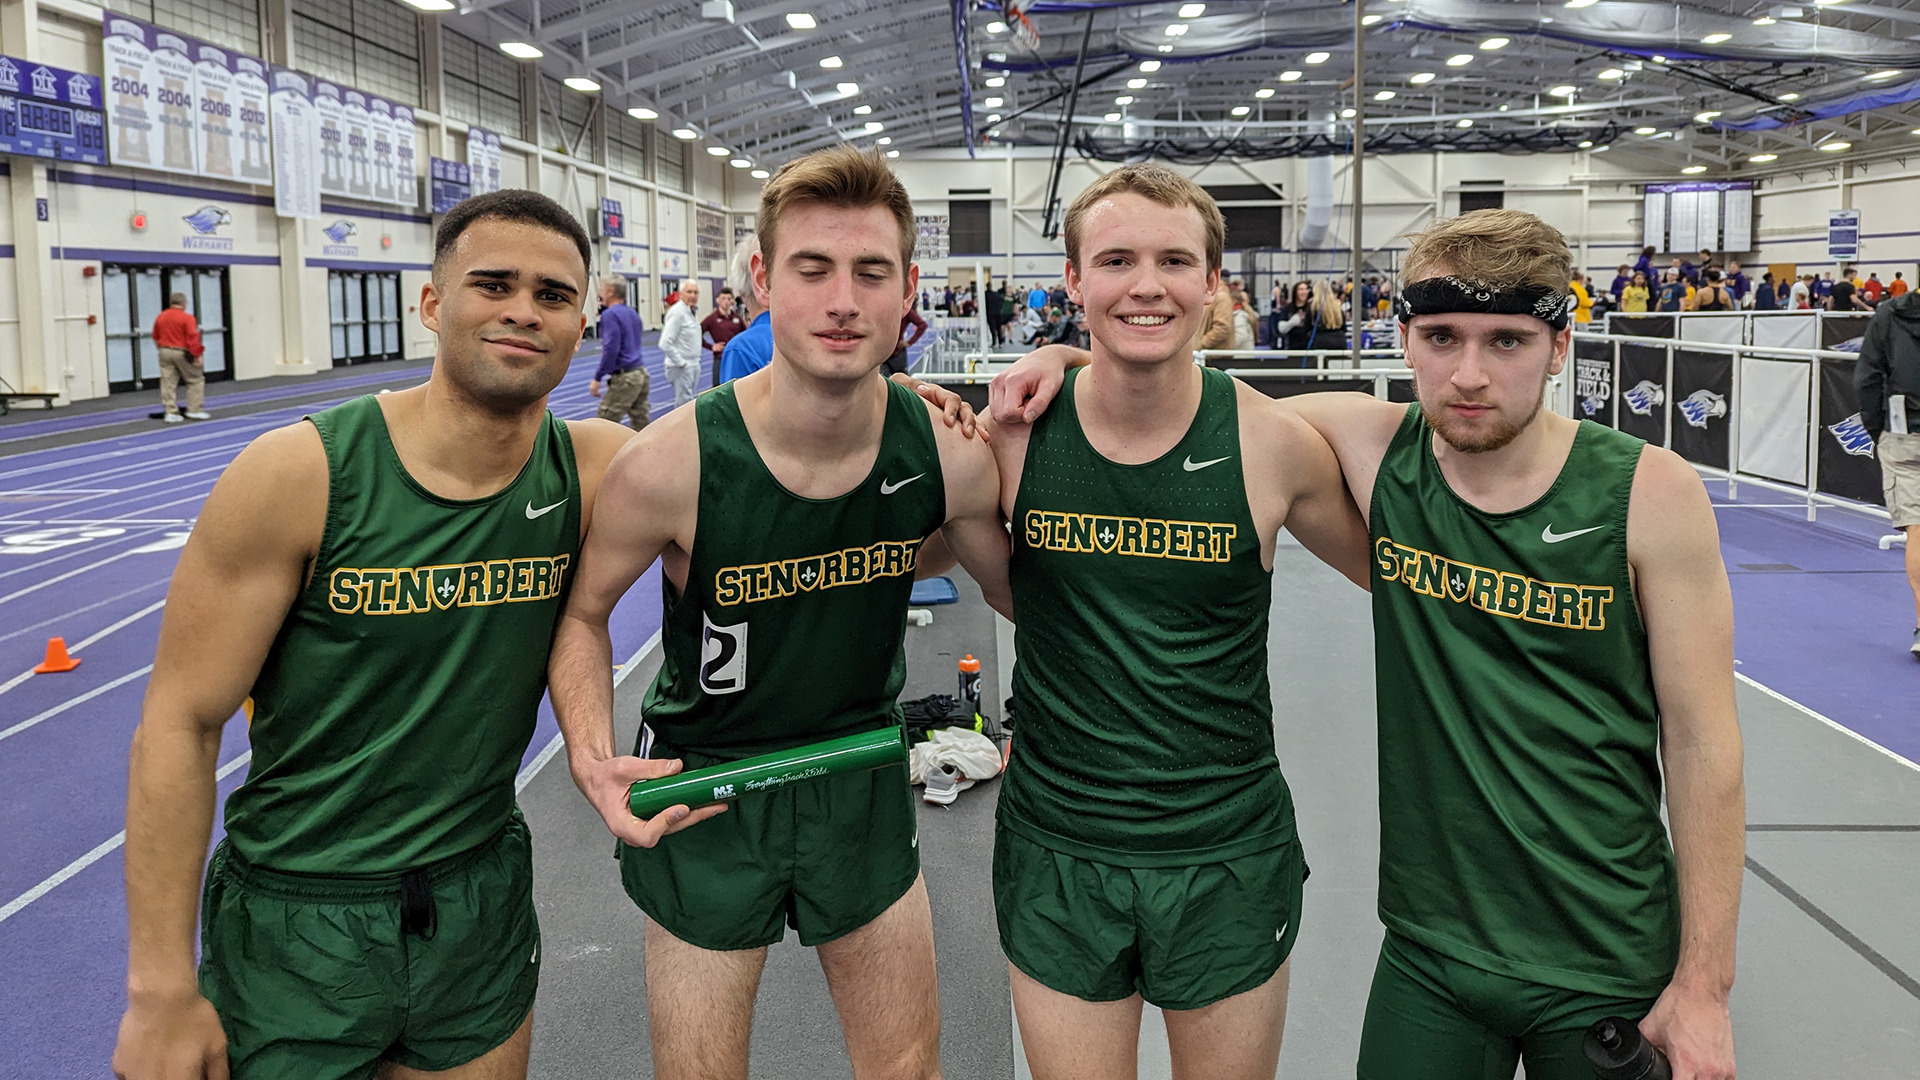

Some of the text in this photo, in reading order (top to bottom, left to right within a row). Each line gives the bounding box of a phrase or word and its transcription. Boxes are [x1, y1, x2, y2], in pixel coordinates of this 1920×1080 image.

[111, 75, 149, 99] 2004
[158, 86, 192, 109] 2004
[201, 98, 232, 118] 2006
[39, 203, 46, 219] 3
[183, 236, 233, 251] WARHAWKS
[1577, 378, 1610, 400] FIELD
[701, 625, 737, 689] 2
